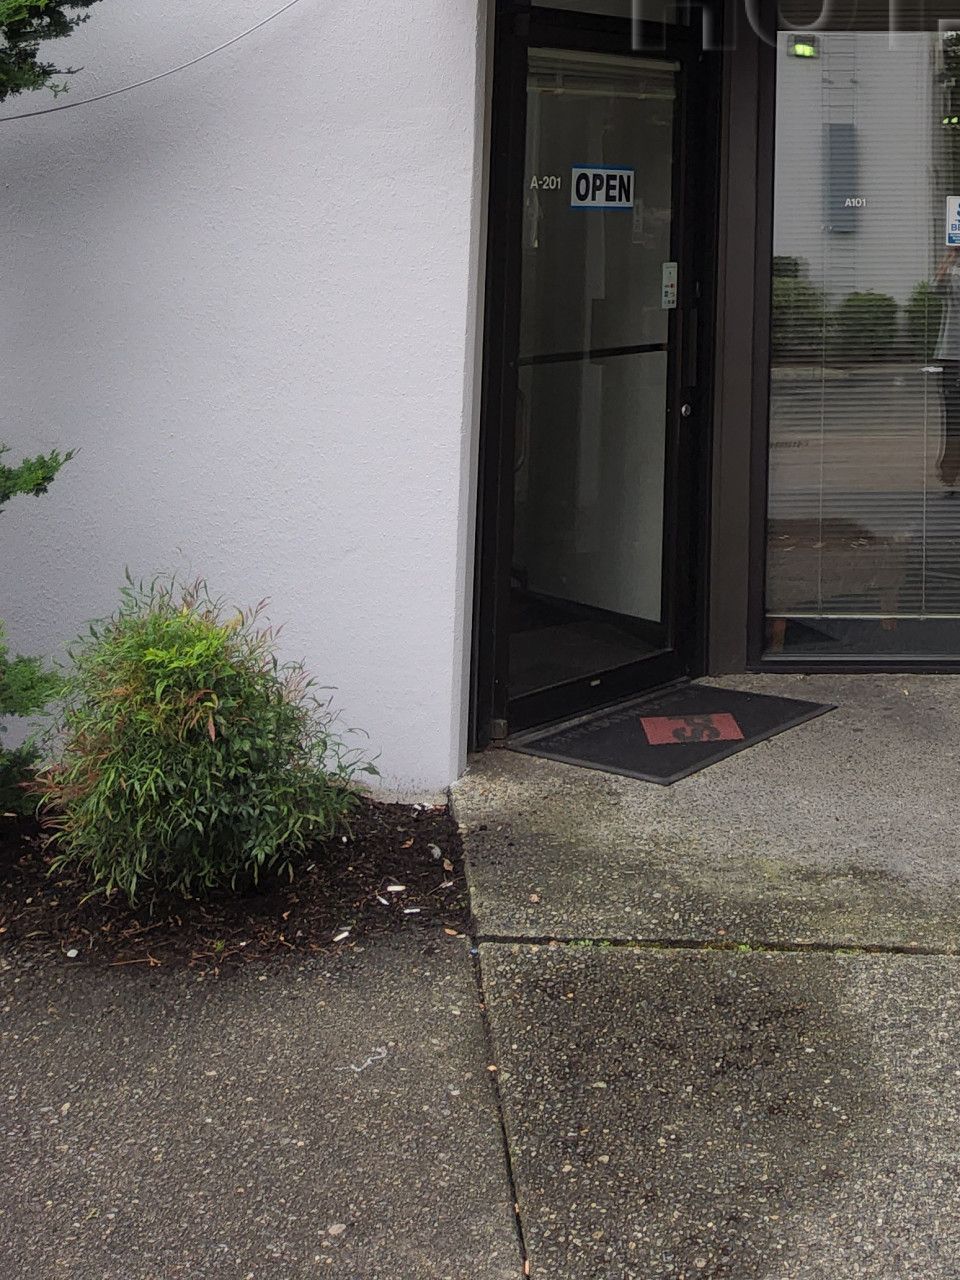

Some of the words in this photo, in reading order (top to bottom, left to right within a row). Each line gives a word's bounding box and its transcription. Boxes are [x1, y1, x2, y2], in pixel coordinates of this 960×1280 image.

[530, 176, 561, 189] A-201
[575, 172, 631, 202] OPEN
[844, 197, 866, 207] A101
